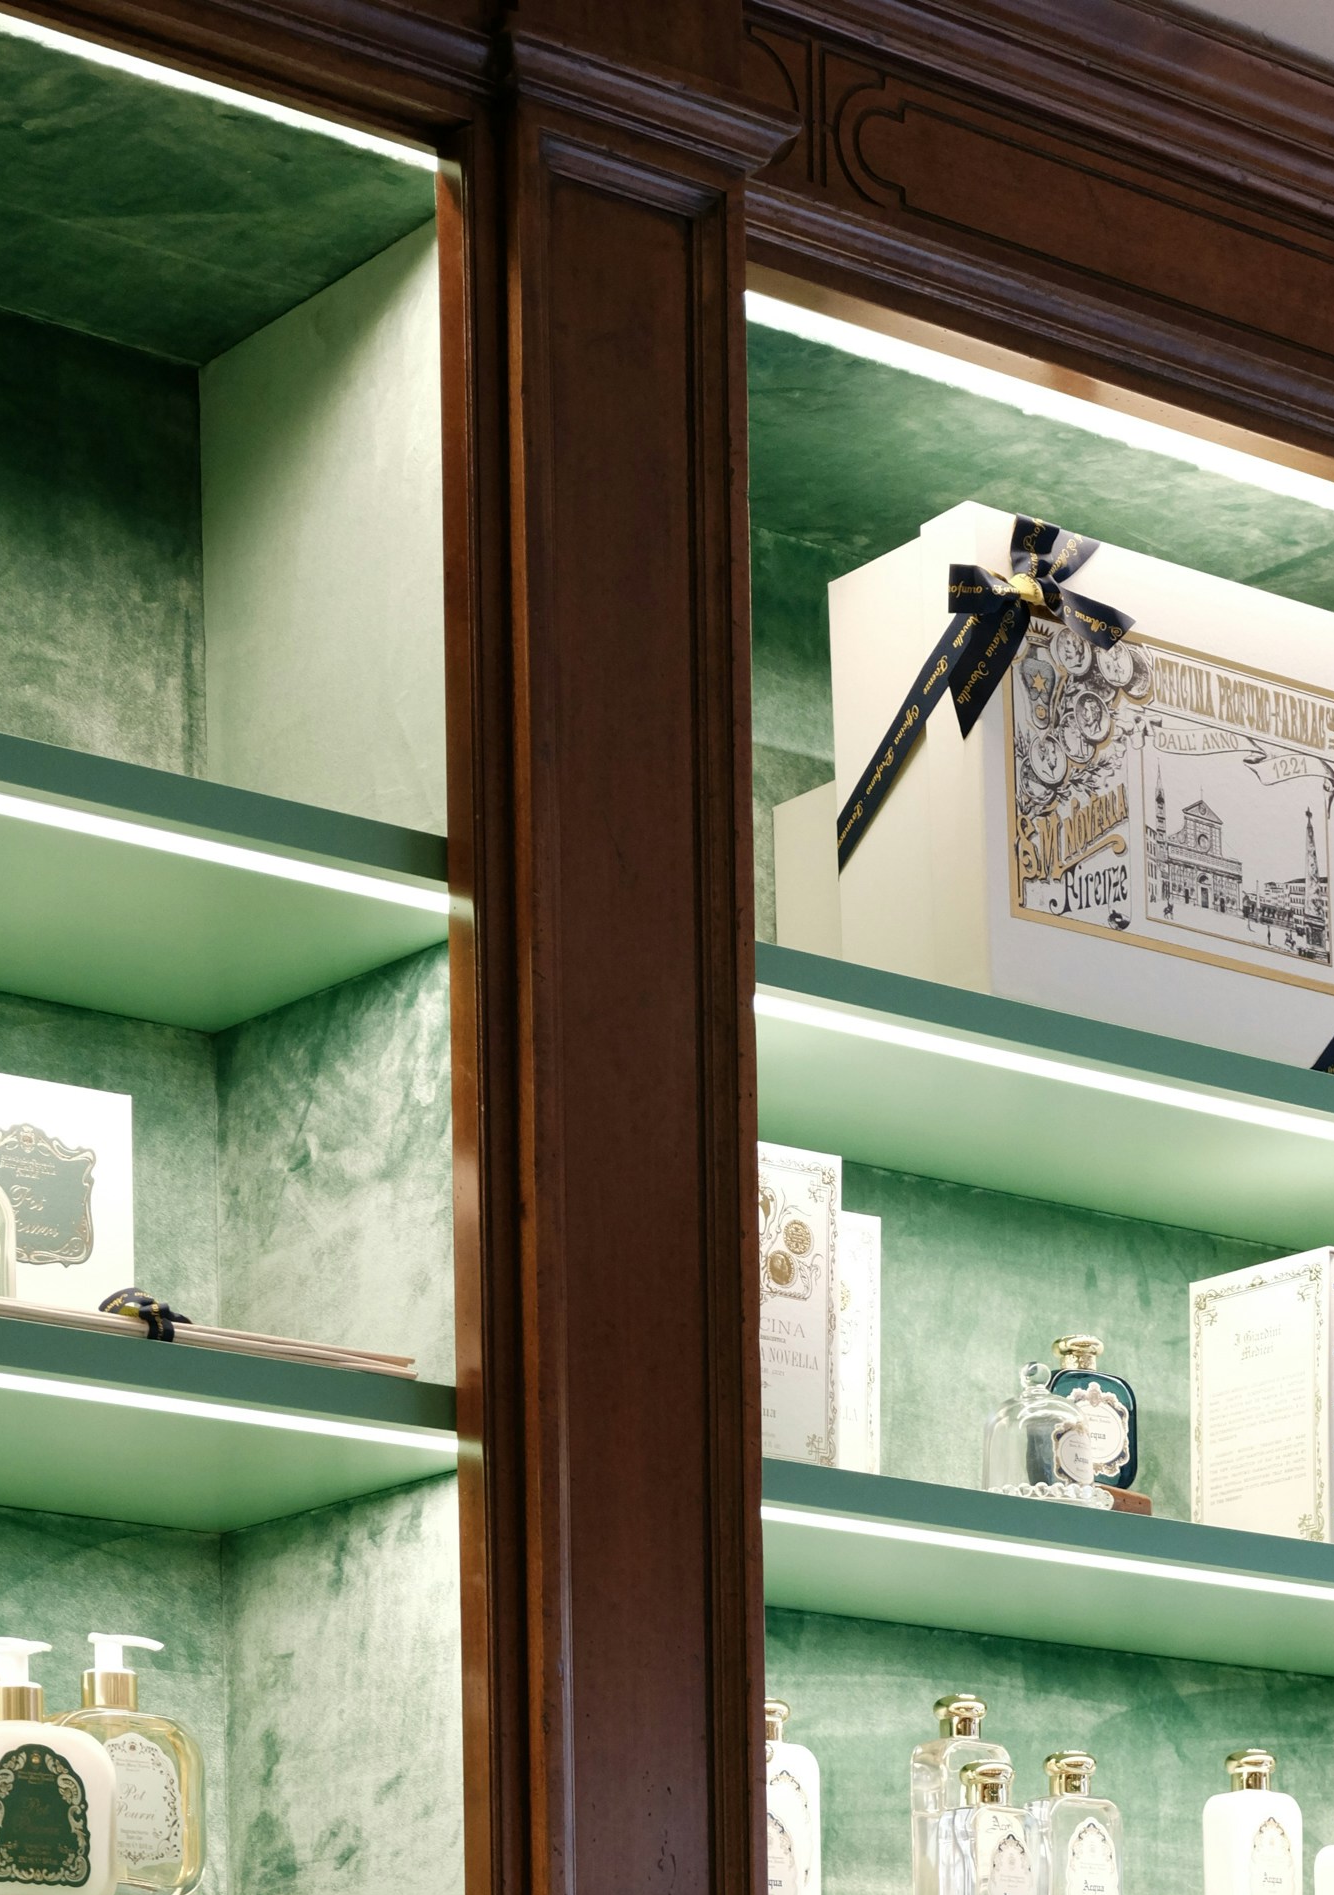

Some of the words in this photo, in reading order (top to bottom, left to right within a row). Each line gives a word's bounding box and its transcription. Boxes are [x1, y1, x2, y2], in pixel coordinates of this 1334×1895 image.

[923, 655, 948, 695] Firenze
[957, 660, 989, 705] Novella
[1154, 657, 1217, 720] OFFICINA
[894, 704, 920, 745] Officina
[1158, 732, 1197, 751] DALL'
[1202, 730, 1239, 750] ANNO
[866, 747, 894, 795] Profumo
[1272, 757, 1308, 780] 1221
[1064, 783, 1129, 860] NOVELLA
[1049, 864, 1128, 916] Firenze
[1243, 1324, 1282, 1344] Giardini
[769, 1345, 819, 1371] NOVELLA
[1089, 1432, 1107, 1441] cqua
[120, 1783, 147, 1802] Pot
[1083, 1880, 1105, 1895] Acqua
